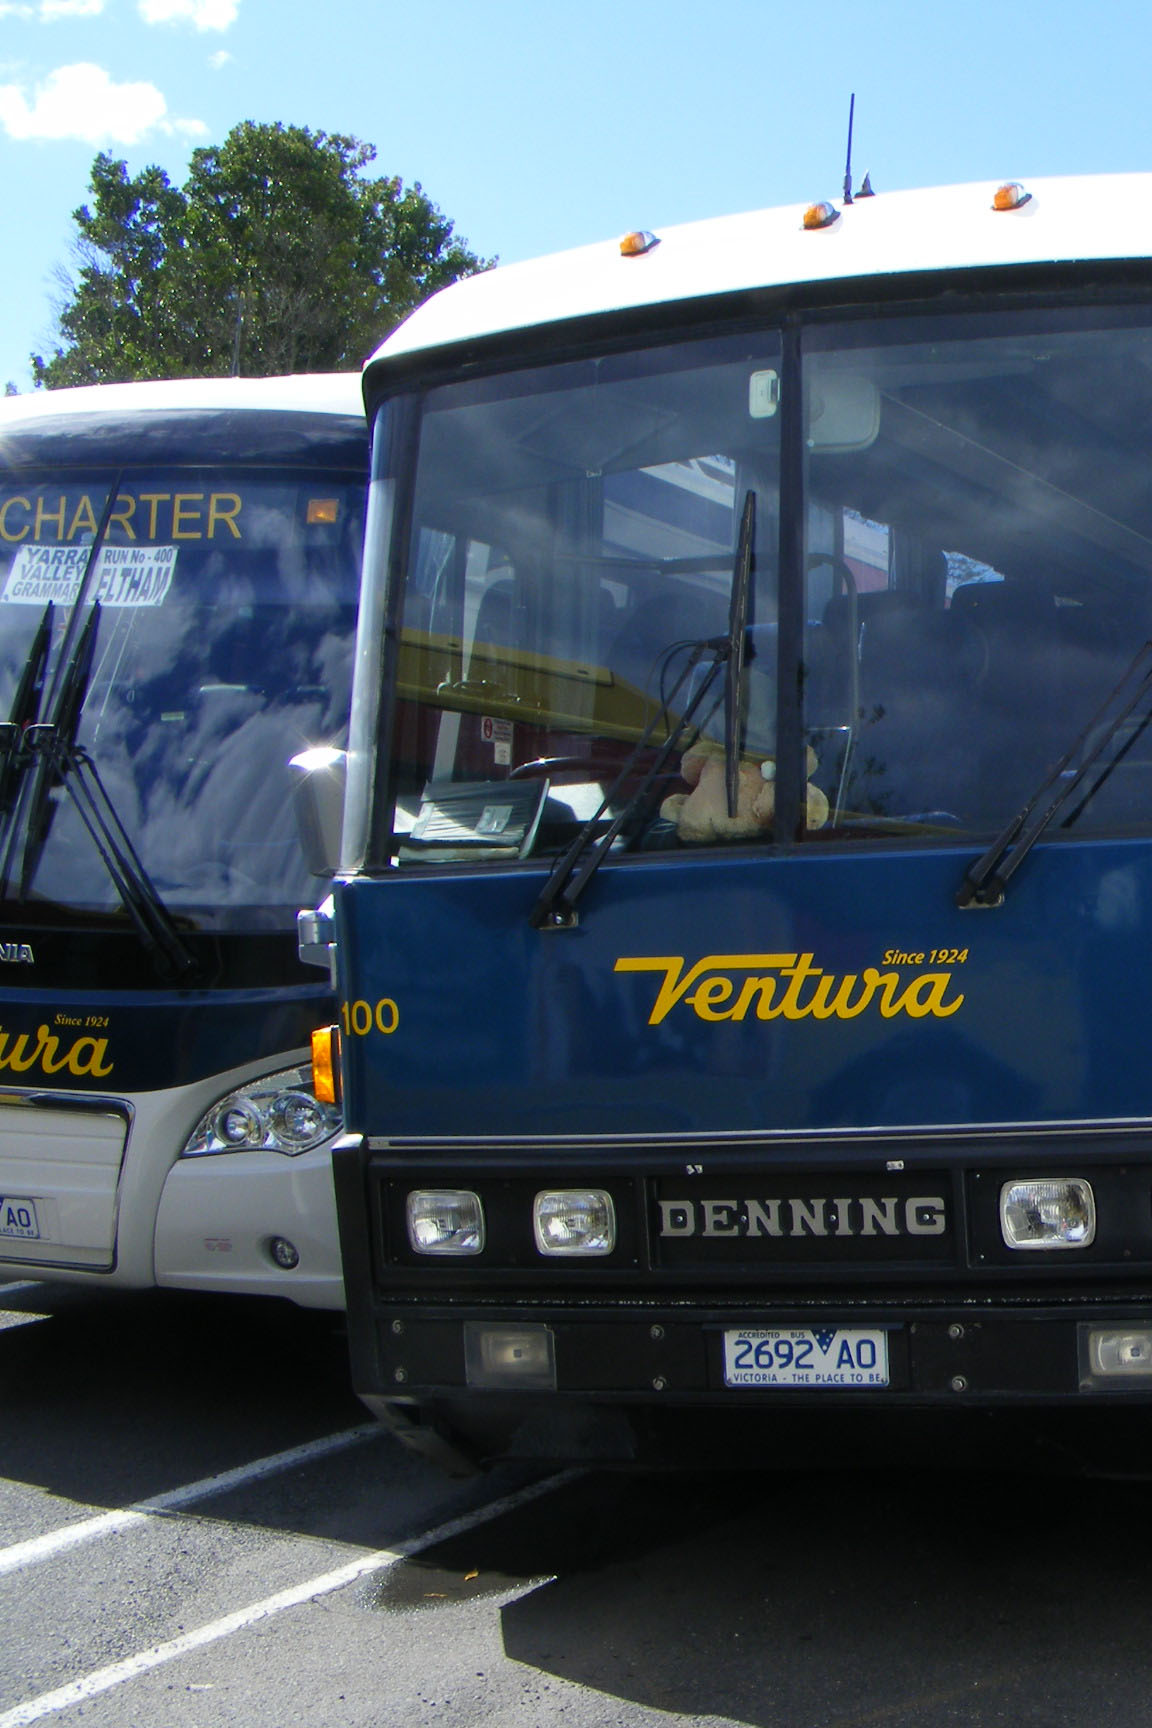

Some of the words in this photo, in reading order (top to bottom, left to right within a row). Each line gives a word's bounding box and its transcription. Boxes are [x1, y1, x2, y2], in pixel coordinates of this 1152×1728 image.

[0, 493, 242, 541] CHARTER
[27, 547, 89, 565] YARRA
[104, 548, 129, 565] RUN
[154, 548, 173, 564] 400
[21, 563, 86, 582] VALLEY
[12, 580, 82, 600] GRAMMAR
[95, 566, 171, 603] ELTHAM
[881, 949, 926, 965] Since
[929, 948, 969, 964] 1924
[613, 952, 965, 1026] Ventura
[54, 1013, 82, 1027] Since
[85, 1015, 110, 1028] 1924
[341, 998, 399, 1036] 100
[0, 1023, 114, 1077] ura
[658, 1197, 945, 1237] DENNING
[738, 1331, 780, 1339] ACCREDITED
[790, 1331, 805, 1339] BUS
[734, 1339, 814, 1370] 2692
[836, 1339, 876, 1370] AO
[733, 1372, 778, 1383] VICTORIA
[792, 1372, 810, 1383] THE
[815, 1372, 845, 1383] PLACE
[851, 1373, 863, 1383] TO
[868, 1372, 880, 1383] BE
